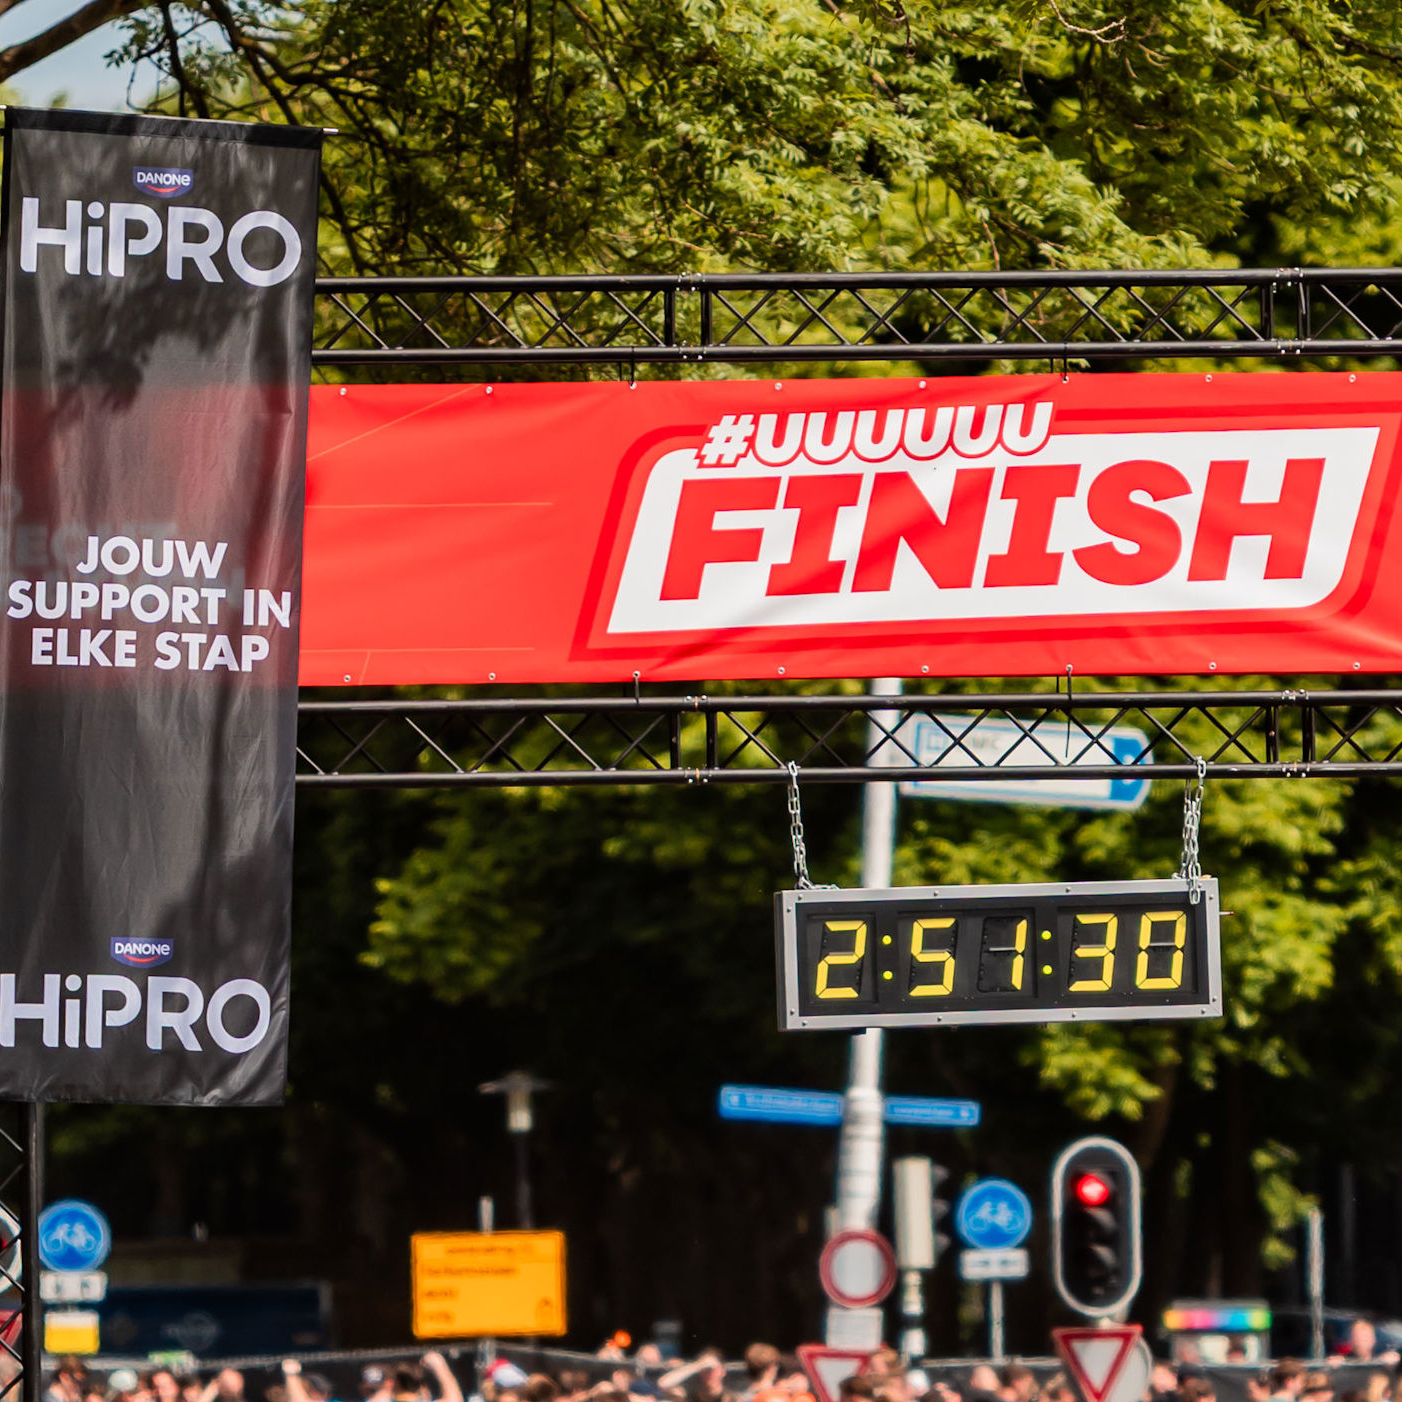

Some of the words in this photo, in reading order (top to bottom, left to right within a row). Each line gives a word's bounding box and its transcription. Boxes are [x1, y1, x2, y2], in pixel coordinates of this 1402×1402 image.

[19, 197, 302, 287] HiPRO
[76, 535, 229, 579] JOUW
[659, 457, 1327, 602] FINISH
[6, 580, 227, 625] SUPPORT
[242, 588, 292, 628] IN
[31, 627, 138, 668] ELKE
[153, 631, 270, 673] STAP
[815, 910, 1188, 999] 2:51:30
